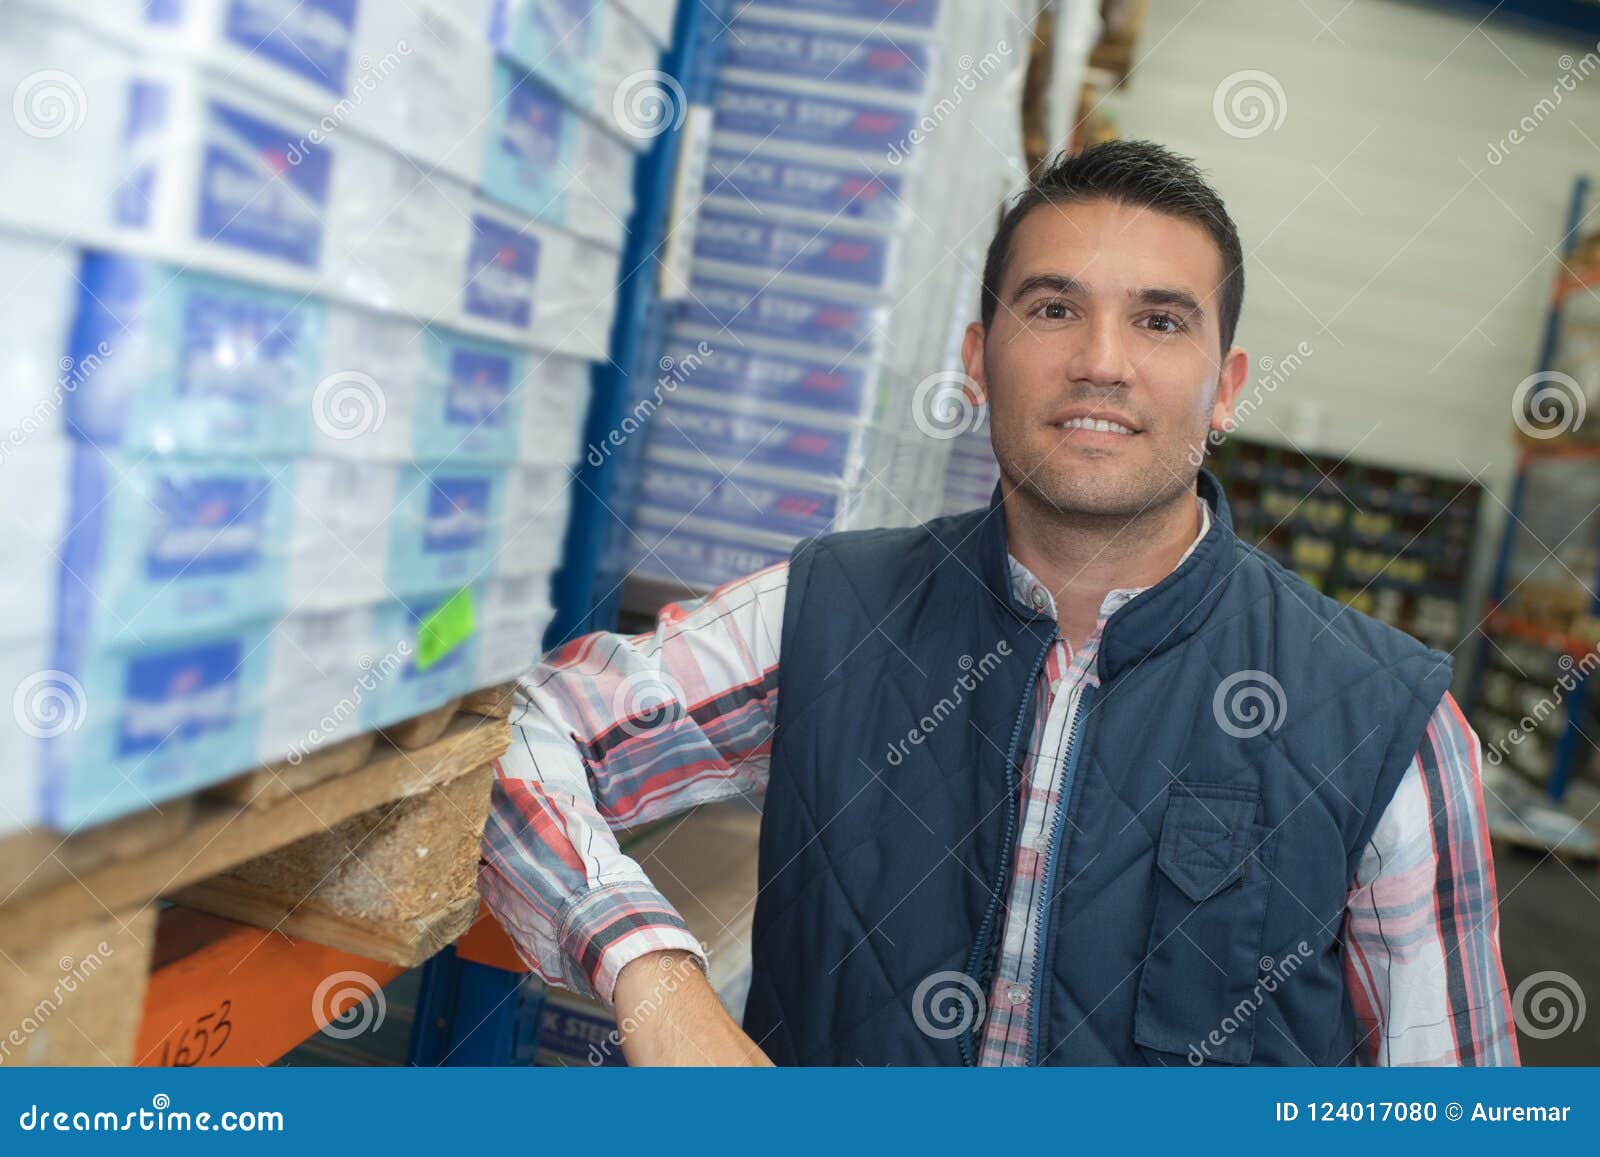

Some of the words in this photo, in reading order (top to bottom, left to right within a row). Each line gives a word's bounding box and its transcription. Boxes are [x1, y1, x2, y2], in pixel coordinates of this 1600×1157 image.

[797, 102, 854, 127] STEP
[783, 167, 839, 192] STEP
[773, 232, 830, 257] STEP
[761, 299, 815, 324] STEP
[748, 357, 802, 384] STEP
[161, 1000, 232, 1067] 1653
